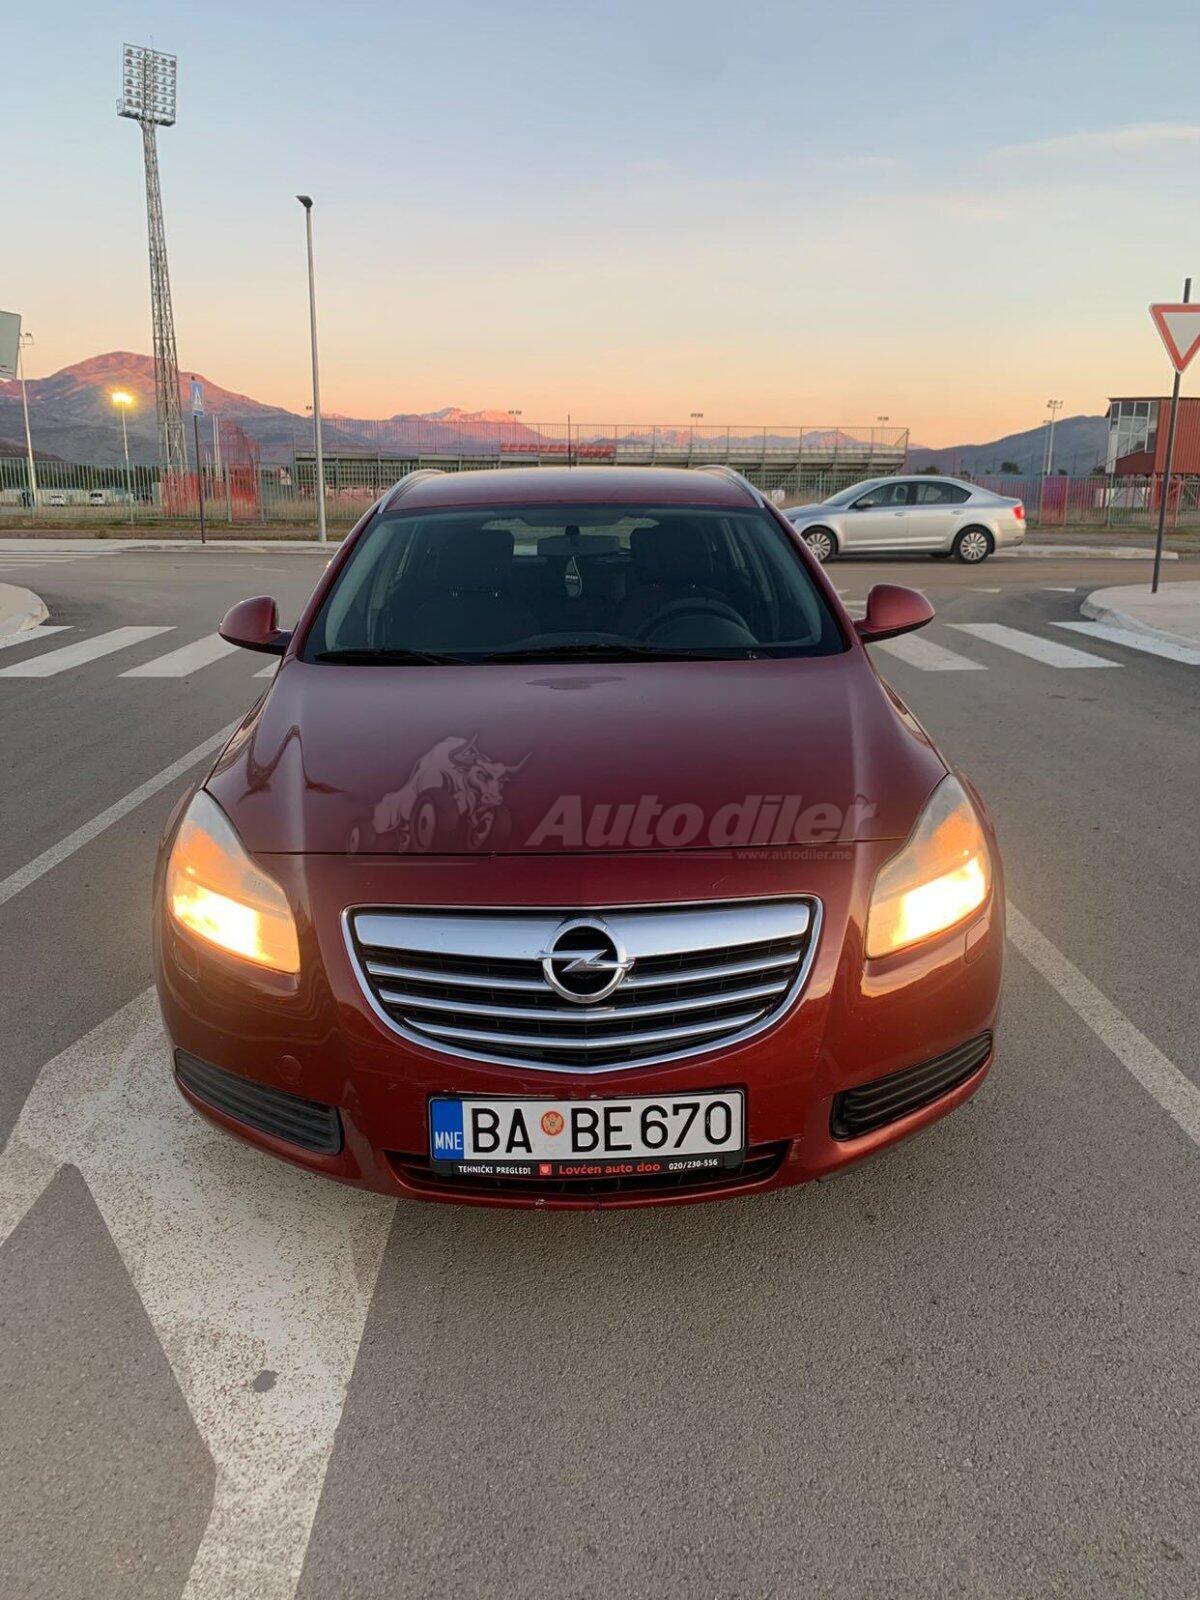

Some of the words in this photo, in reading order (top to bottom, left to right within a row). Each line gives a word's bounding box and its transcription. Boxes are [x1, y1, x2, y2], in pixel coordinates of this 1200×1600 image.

[472, 1107, 533, 1154] BA
[435, 1131, 463, 1150] MNE
[458, 1164, 493, 1174] TEHNIČKI
[496, 1165, 532, 1175] PREGLEDI
[559, 1163, 602, 1175] Lovćen
[605, 1163, 633, 1174] auto
[637, 1161, 661, 1173] doo
[668, 1158, 718, 1171] 020/230-556
